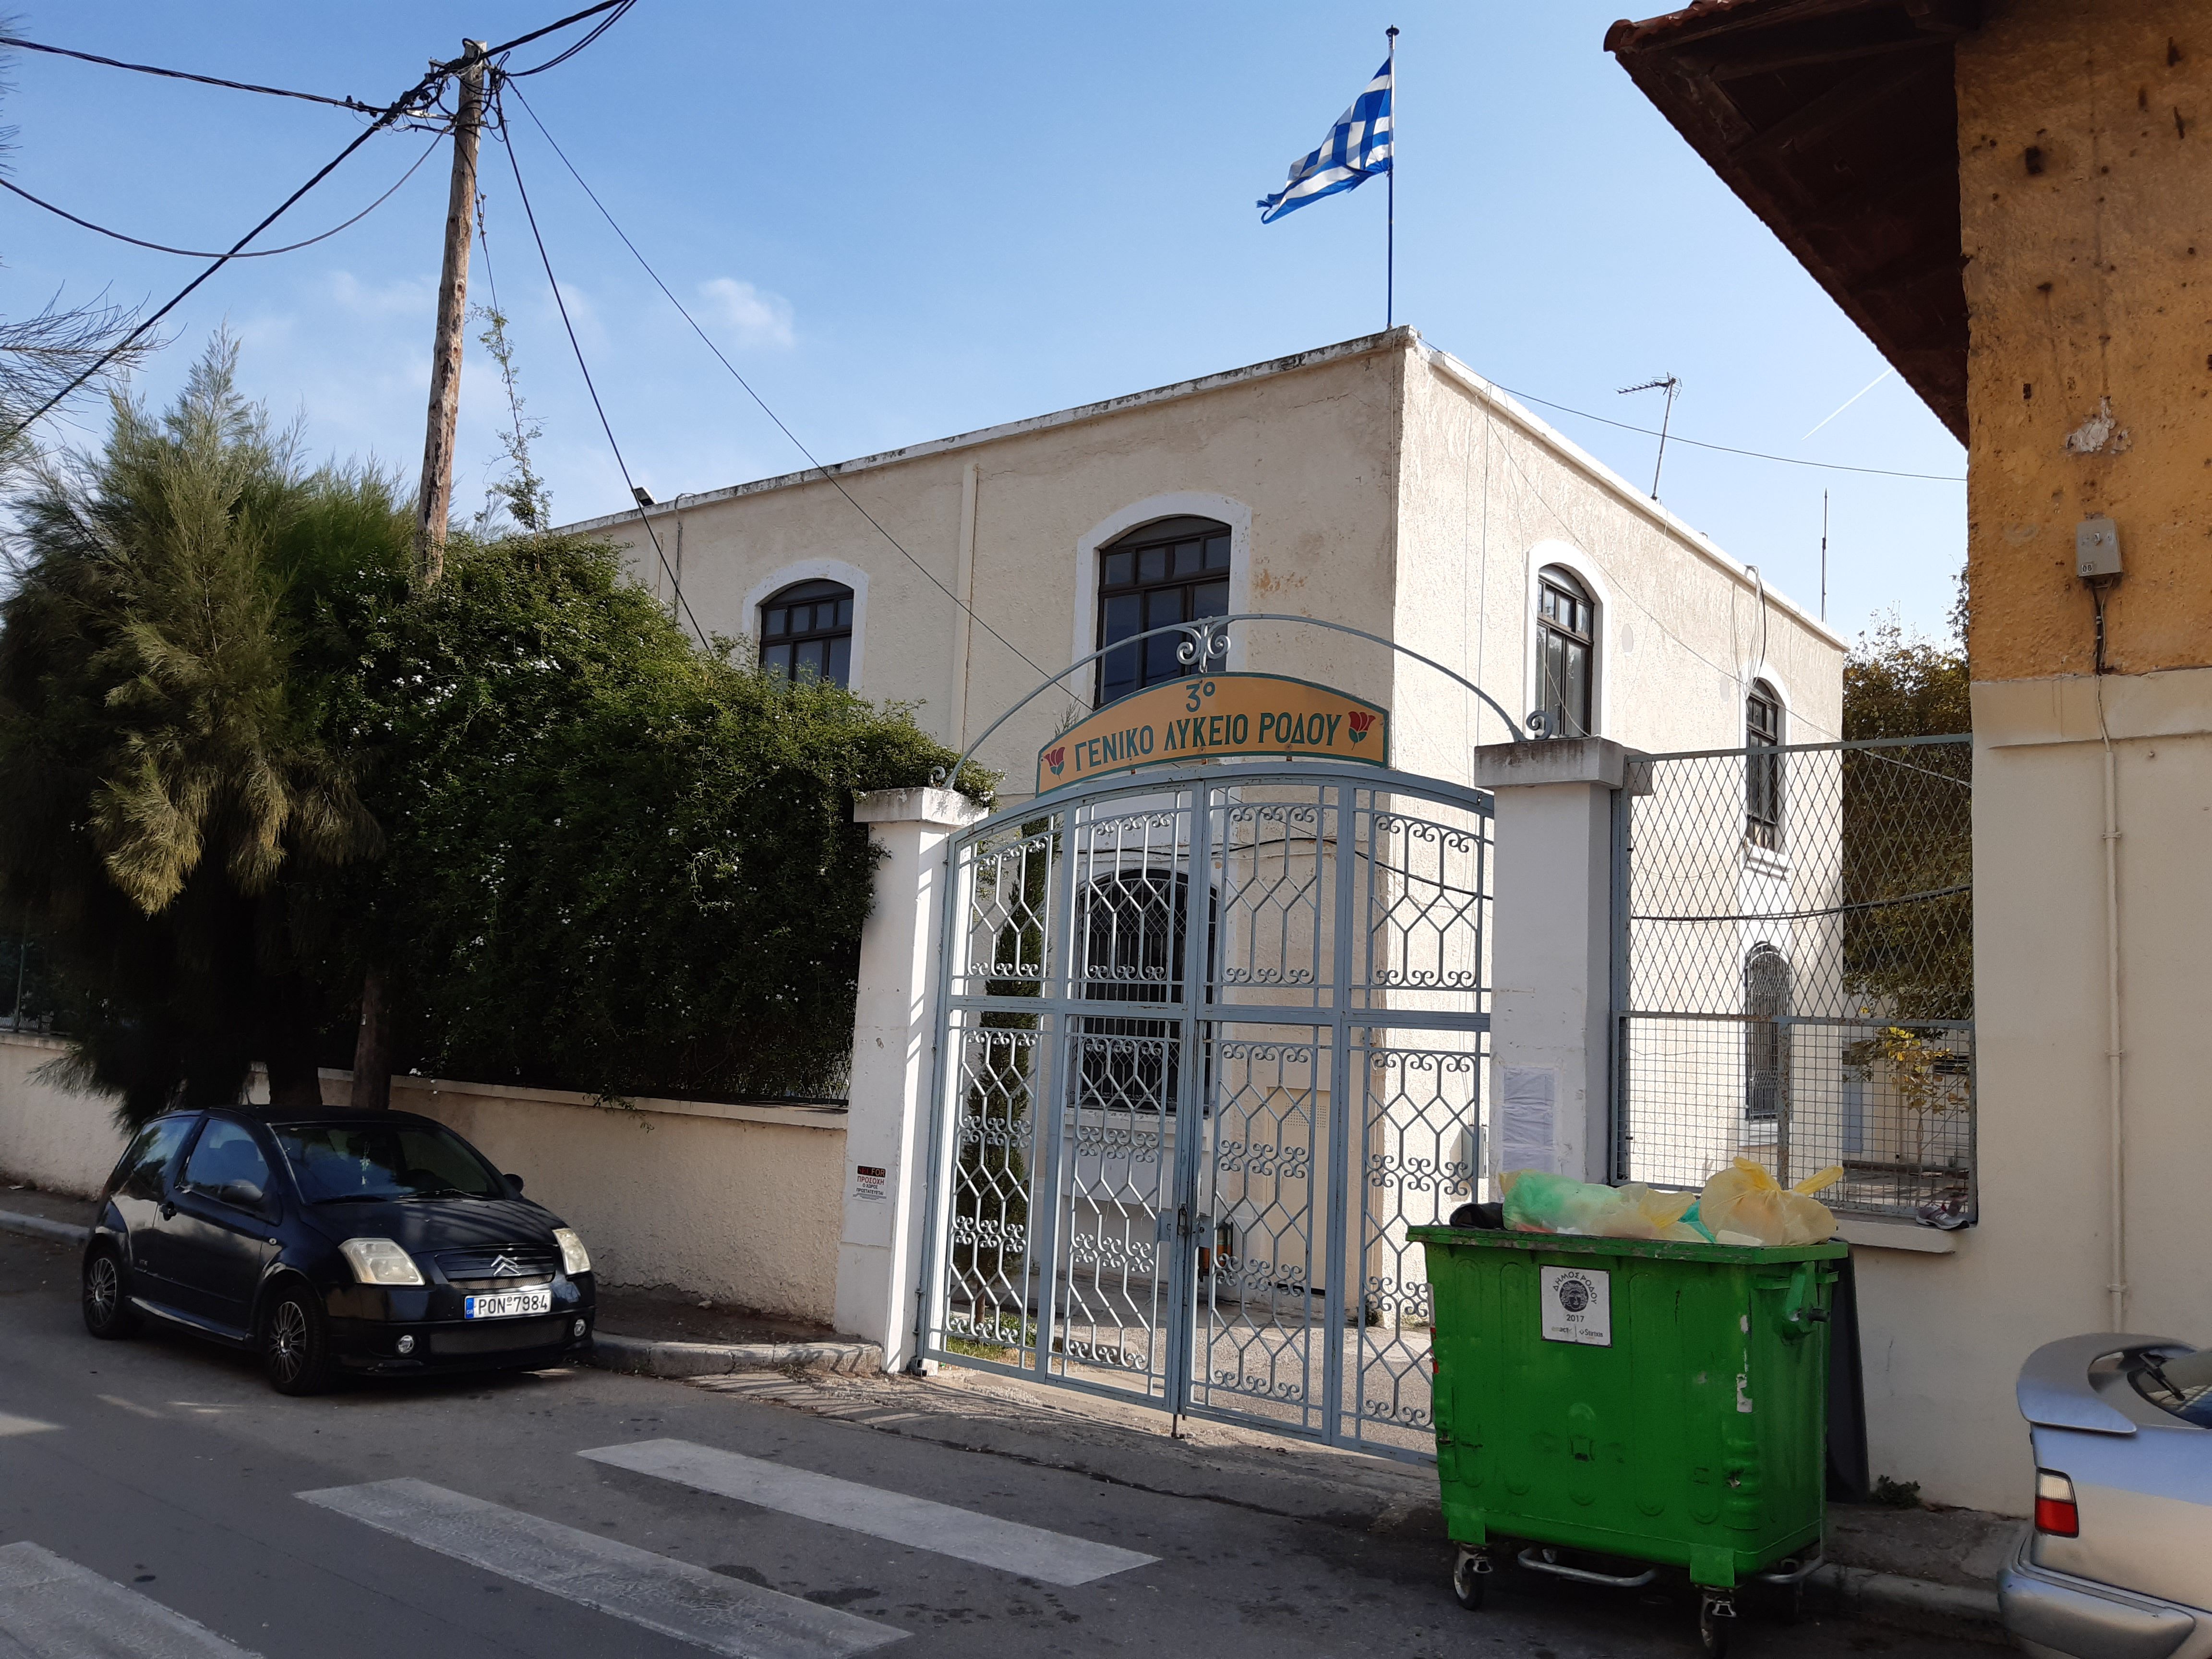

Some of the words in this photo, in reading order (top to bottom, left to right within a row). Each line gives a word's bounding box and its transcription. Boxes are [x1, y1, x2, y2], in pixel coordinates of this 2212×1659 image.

[1074, 725, 1154, 772] ΓΕΝΙΚΟ
[1164, 713, 1248, 751] ΛΥΚΕΙΟ
[1257, 712, 1342, 747] ΡΟΔΟΥ
[857, 1176, 885, 1186] ΠΡΟΣΟΧΗ
[1553, 1272, 1580, 1291] ΔΗΜΟΣ
[1580, 1274, 1598, 1305] ΡΟΔΟΥ
[1566, 1314, 1585, 1322] 2017
